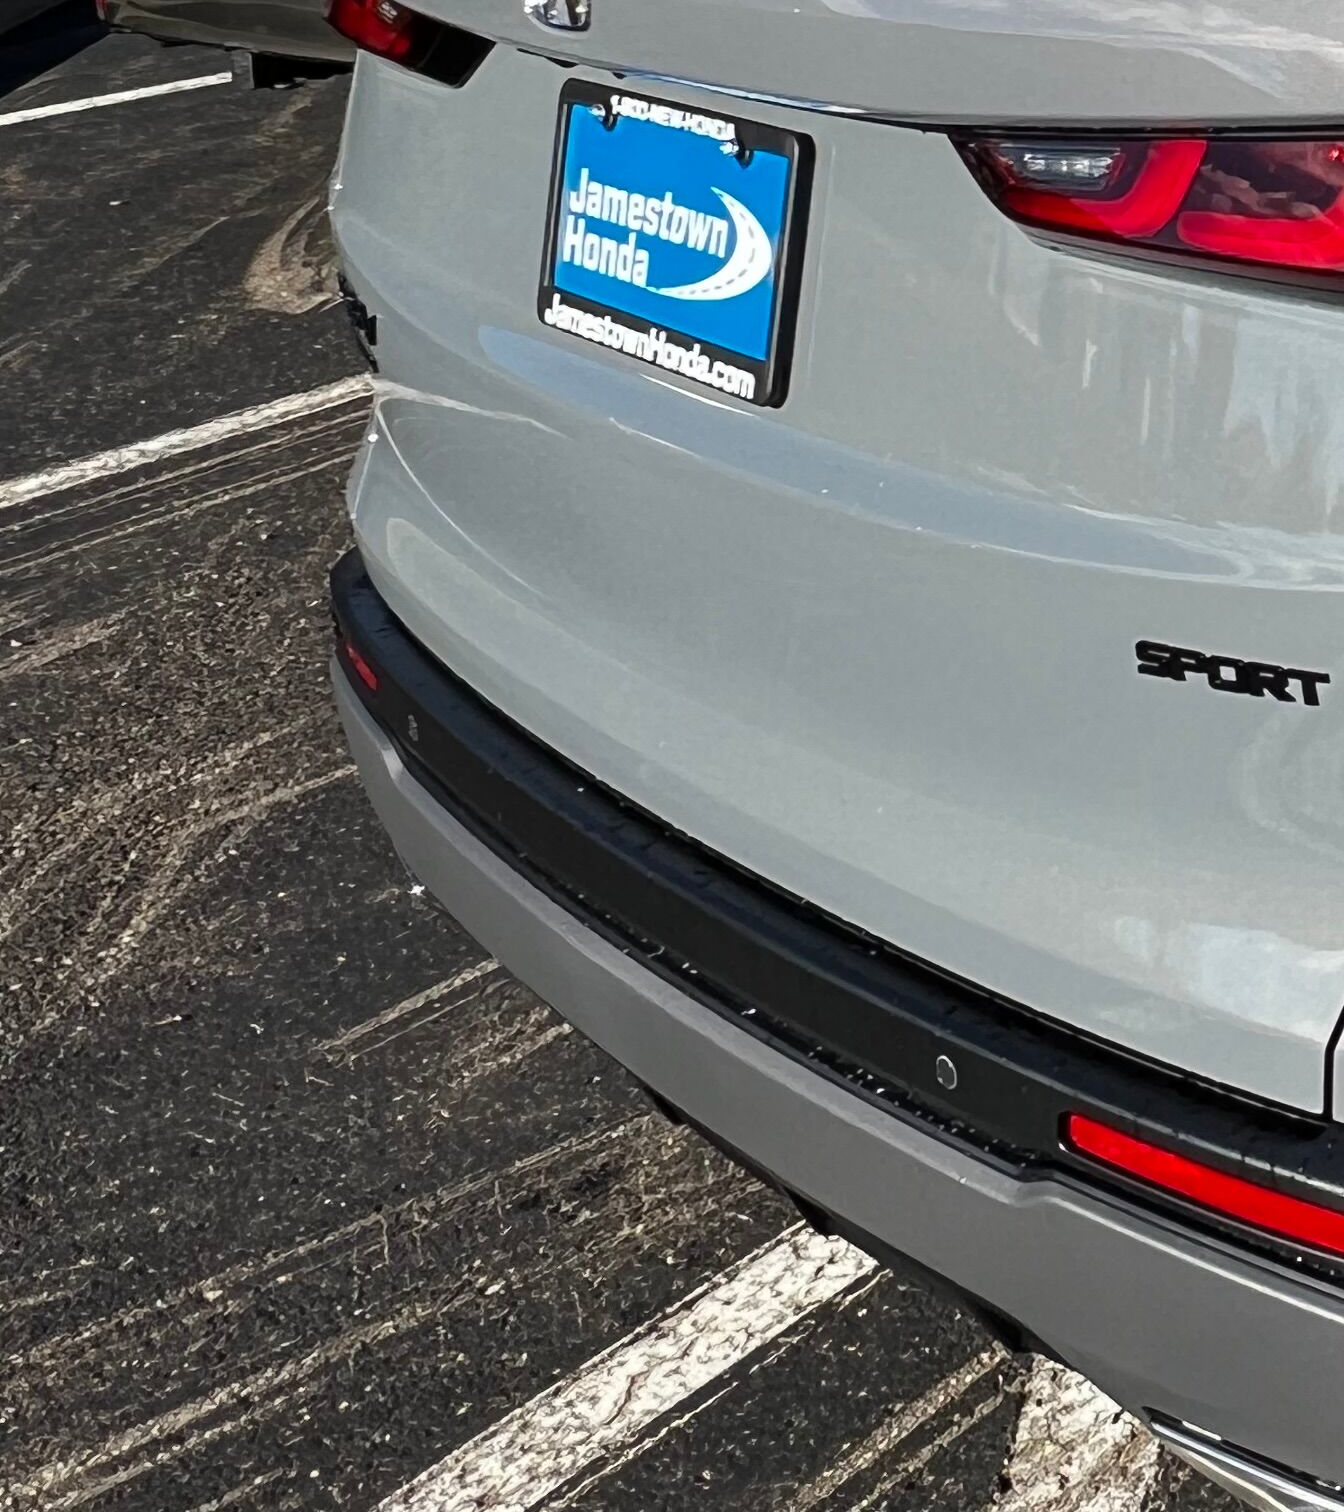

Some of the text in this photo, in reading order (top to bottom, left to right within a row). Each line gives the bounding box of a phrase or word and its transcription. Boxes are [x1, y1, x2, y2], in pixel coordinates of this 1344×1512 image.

[562, 214, 650, 288] Honda
[569, 168, 729, 259] Jamestown
[544, 293, 756, 400] JamestownHonda.com
[1135, 639, 1331, 706] SPORT
